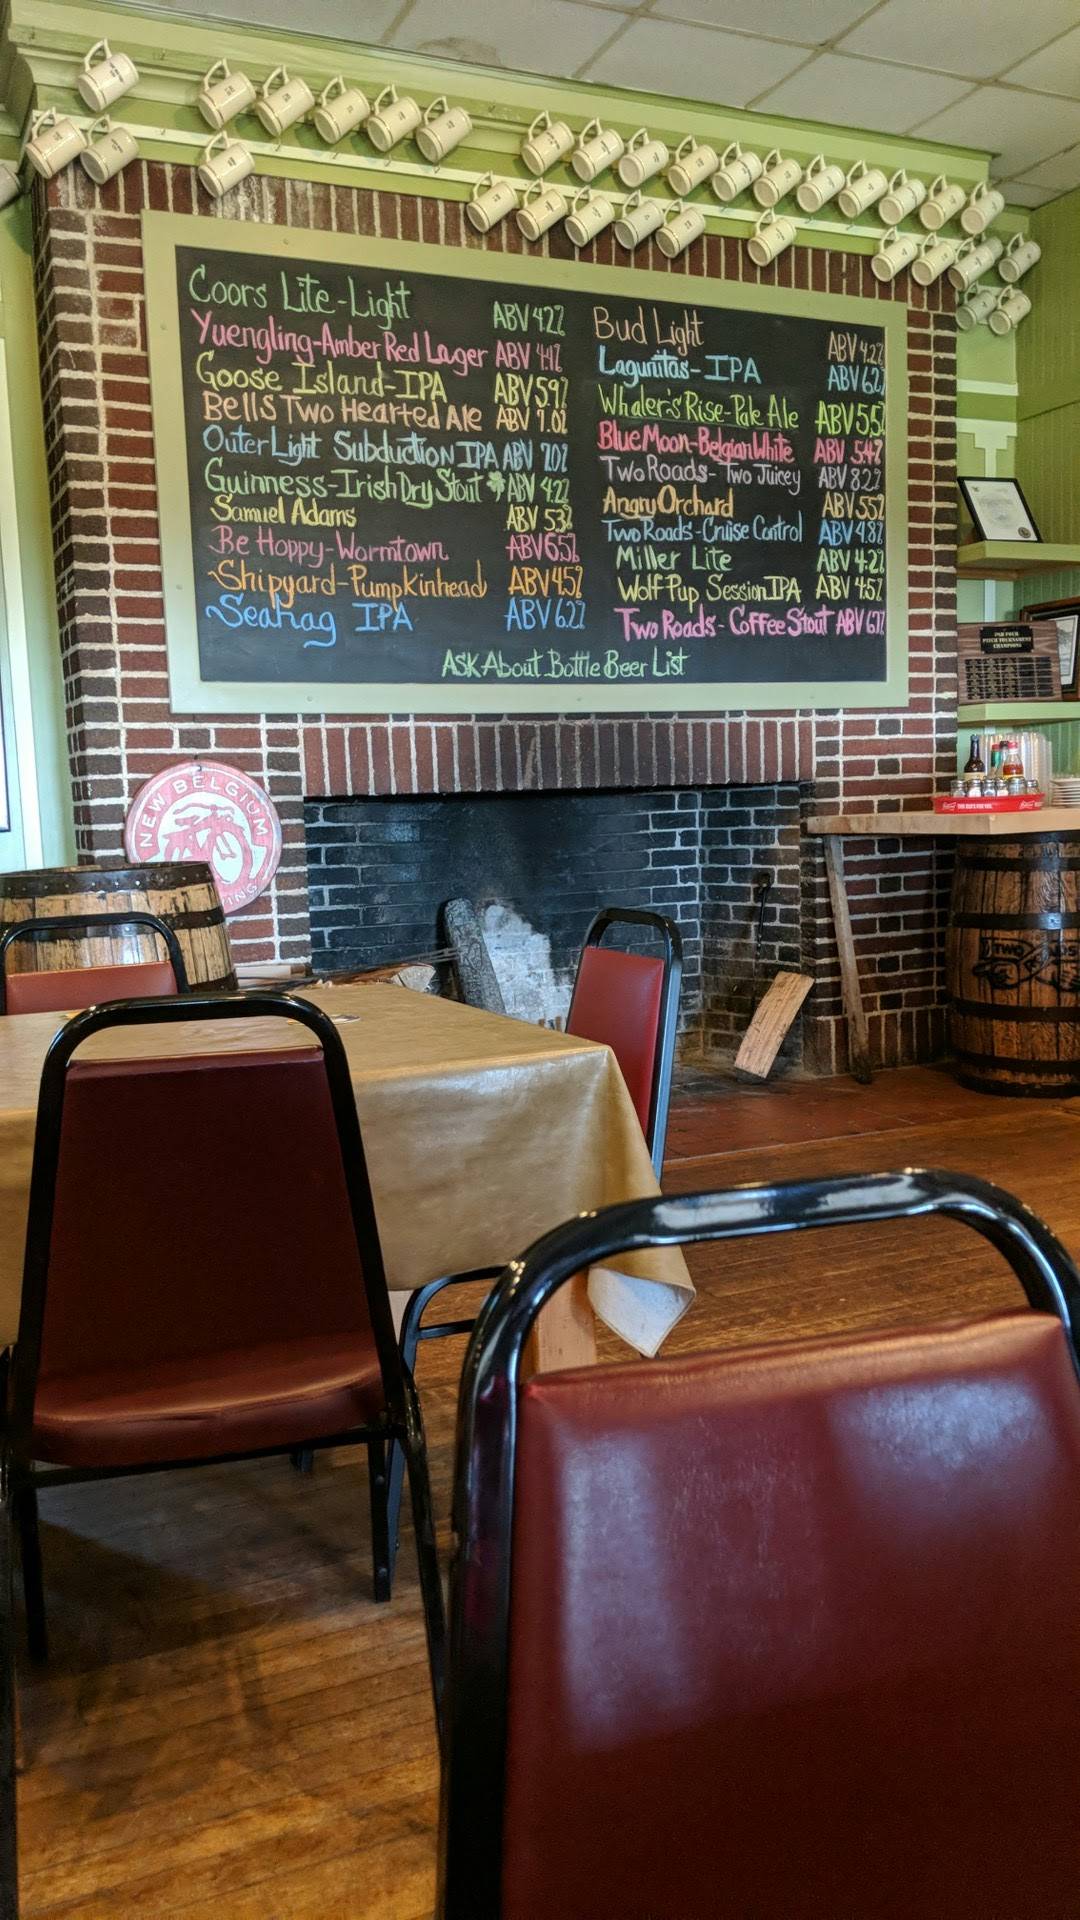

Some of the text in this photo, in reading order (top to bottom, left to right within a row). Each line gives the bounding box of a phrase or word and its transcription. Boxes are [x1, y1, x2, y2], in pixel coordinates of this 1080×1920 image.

[189, 264, 268, 309] Coors
[494, 301, 530, 332] ABV
[384, 331, 420, 364] Red
[425, 331, 489, 376] Lager
[496, 340, 531, 370] ABV
[593, 305, 648, 345] Bud
[653, 308, 704, 356] Light
[827, 330, 858, 362] ABV
[196, 350, 282, 391] Goose
[495, 372, 533, 408] ABV
[703, 354, 762, 385] IPA
[827, 364, 860, 392] ABV
[203, 391, 276, 423] Bells
[280, 395, 334, 424] Two
[342, 397, 439, 430] Hearted
[445, 404, 482, 432] Ale
[496, 404, 530, 432] ABV
[767, 394, 799, 429] Ale
[814, 400, 855, 435] ABV
[203, 424, 269, 455] Outer
[271, 425, 322, 466] Light
[455, 441, 498, 470] IPA
[503, 438, 533, 471] ABV
[597, 419, 642, 450] Blue
[752, 431, 796, 463] White
[813, 438, 845, 464] ABV
[399, 473, 433, 509] Dry
[435, 468, 484, 503] Stout
[507, 472, 536, 503] ABV
[599, 455, 646, 483] Two
[718, 462, 752, 485] Two
[752, 463, 801, 496] Juicey
[818, 464, 848, 490] ABV
[209, 492, 285, 524] Samuel
[291, 498, 357, 528] Adams
[506, 503, 539, 532] ABV
[602, 485, 657, 520] Angry
[657, 484, 734, 518] Orchard
[822, 491, 854, 519] ABV
[208, 525, 250, 555] Be
[505, 532, 543, 562] ABV
[601, 518, 641, 543] Two
[752, 510, 803, 543] Control
[818, 519, 853, 546] ABV
[615, 545, 681, 572] Miller
[691, 546, 733, 572] Lite
[816, 547, 850, 574] ABV
[508, 564, 550, 598] ABV
[616, 574, 664, 603] Wolf
[661, 574, 700, 614] Pup
[706, 573, 767, 602] Session
[764, 575, 802, 603] IPA
[816, 573, 850, 600] ABV
[204, 591, 338, 649] Seahag
[352, 601, 414, 632] IPA
[504, 596, 551, 632] ABV
[613, 607, 658, 641] Two
[786, 604, 835, 637] Stout
[836, 608, 864, 636] ABV
[481, 648, 544, 678] About
[544, 648, 601, 679] Bottle
[604, 649, 650, 679] Beer
[652, 645, 691, 677] List
[139, 775, 269, 848] NEW BELGIUM
